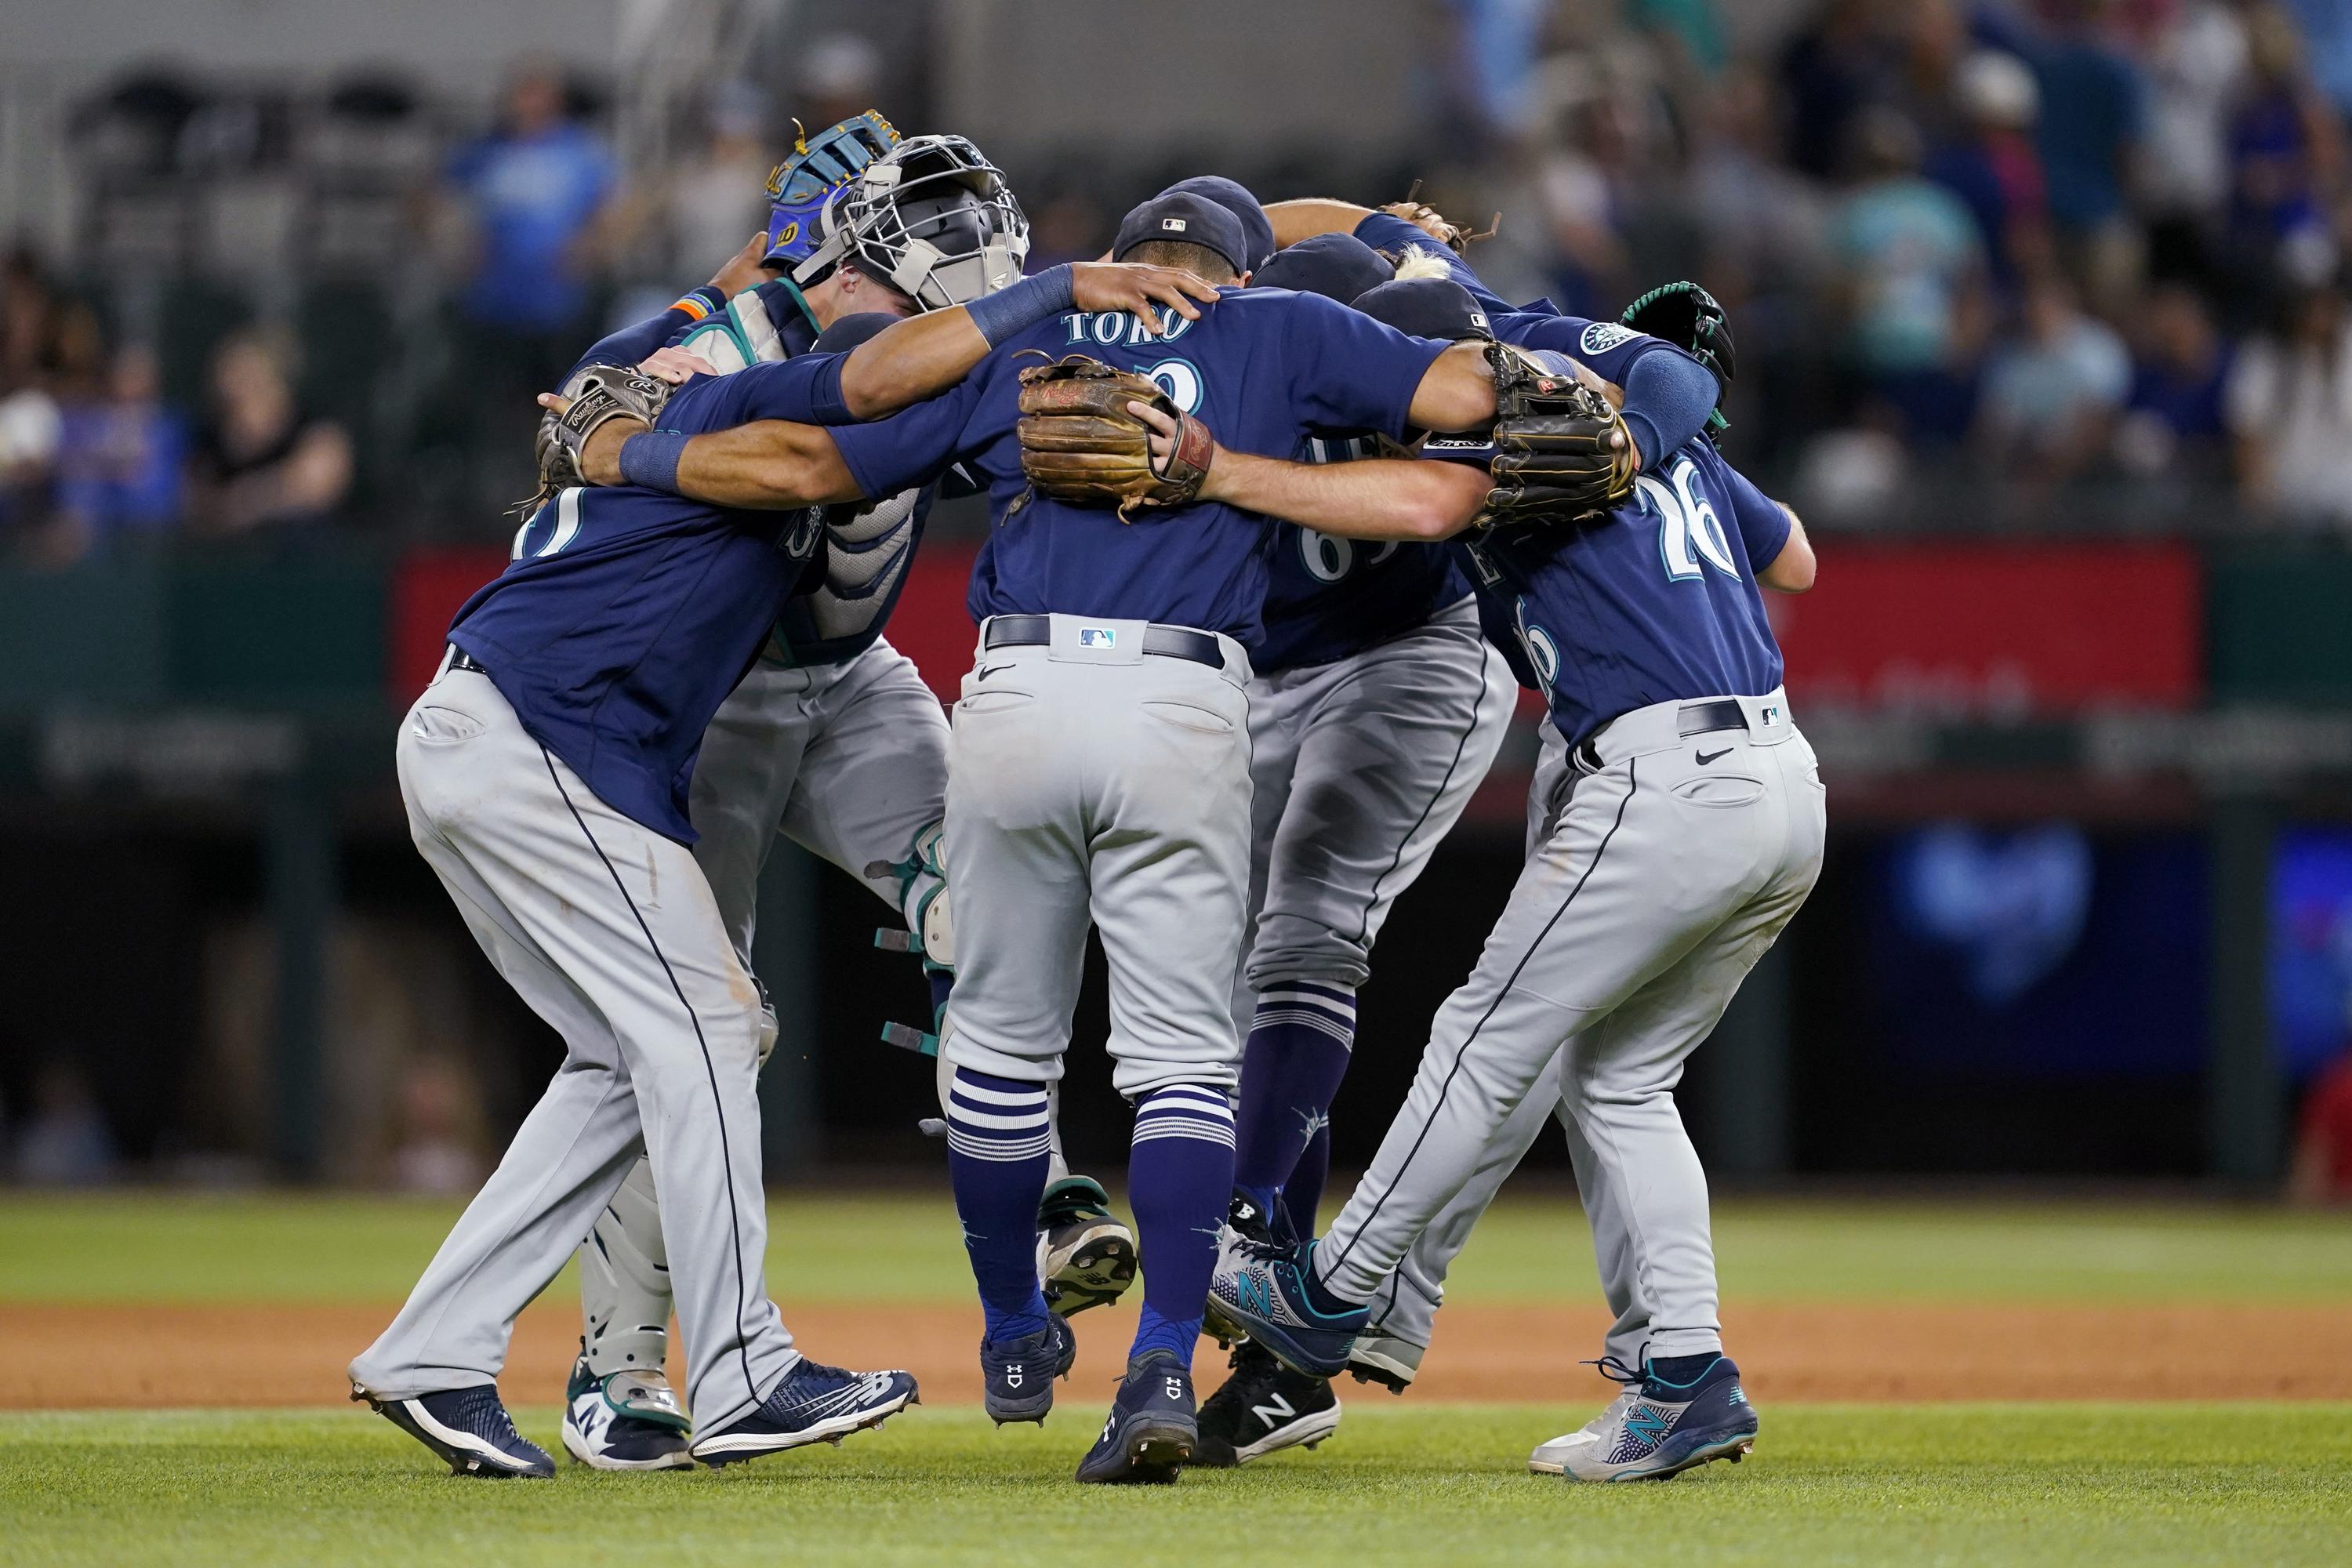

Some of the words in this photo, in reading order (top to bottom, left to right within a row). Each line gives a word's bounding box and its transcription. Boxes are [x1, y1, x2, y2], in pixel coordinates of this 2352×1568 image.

[572, 394, 606, 426] Rawlings
[1635, 455, 1743, 583] 26
[1238, 1269, 1273, 1318] N
[578, 1401, 607, 1440] N
[1251, 1392, 1297, 1429] N
[1624, 1405, 1668, 1446] N
